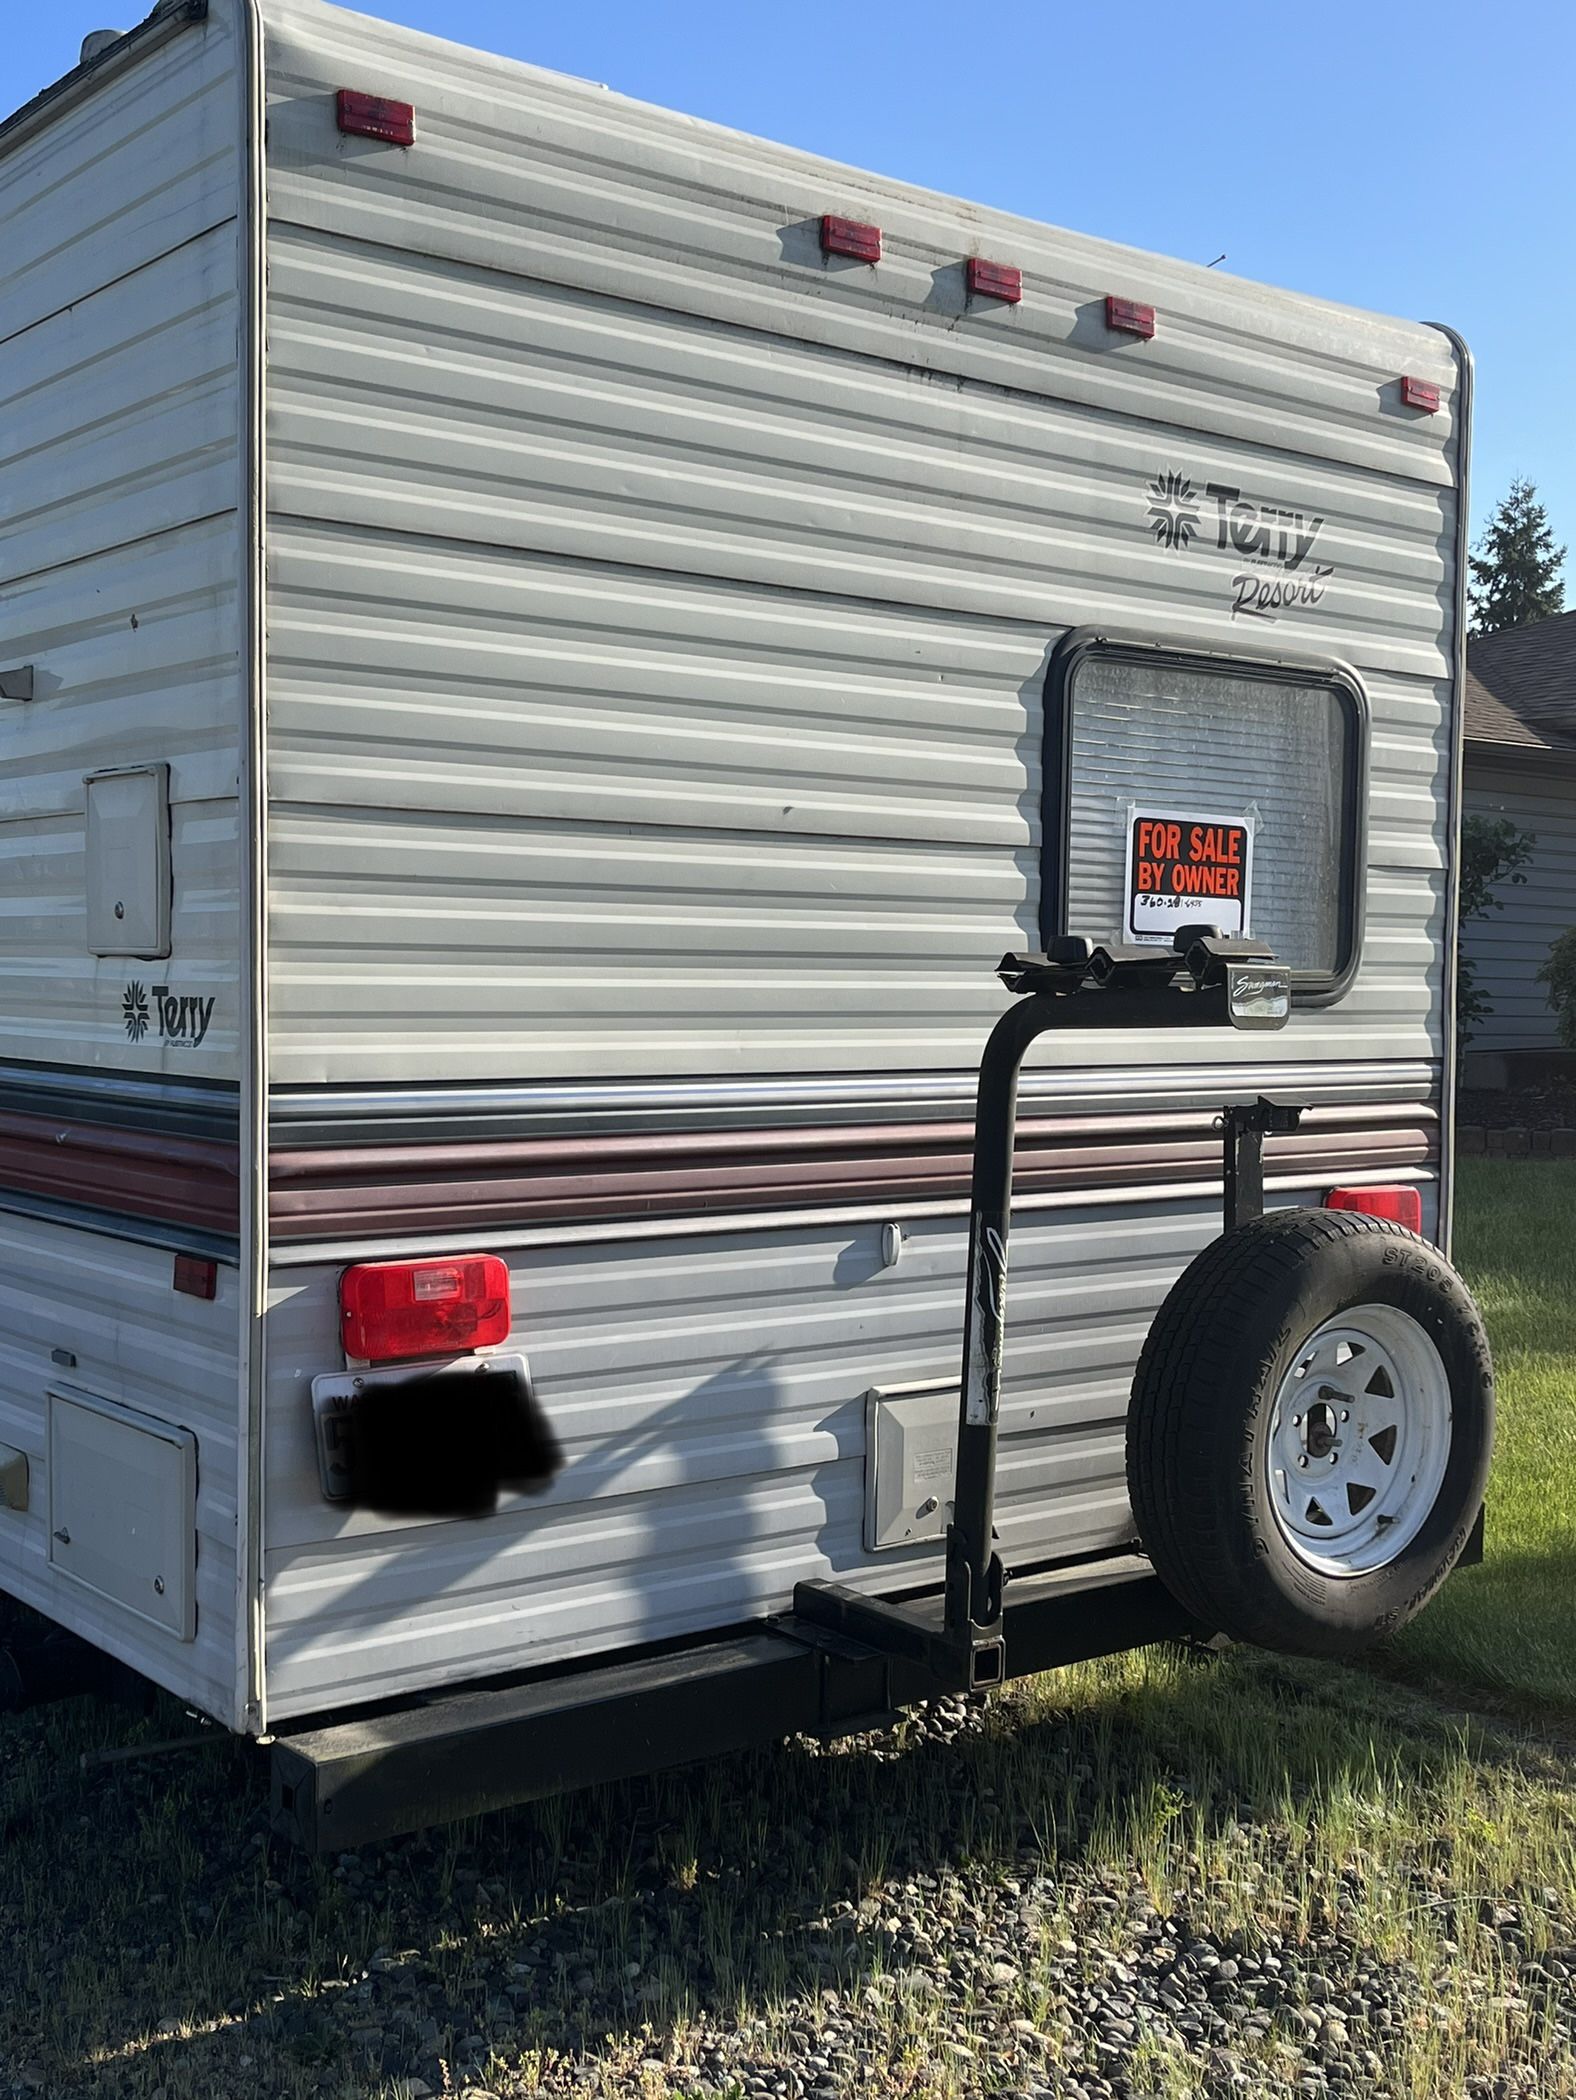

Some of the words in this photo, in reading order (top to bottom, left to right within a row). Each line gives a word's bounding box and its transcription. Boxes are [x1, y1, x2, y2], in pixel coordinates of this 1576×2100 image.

[1206, 482, 1325, 570] Terry
[1231, 565, 1335, 623] Resort
[1139, 821, 1182, 860] FOR
[1188, 826, 1242, 864] SALE
[1137, 861, 1166, 891] BY
[1171, 863, 1240, 896] OWNER
[151, 985, 216, 1048] Terry
